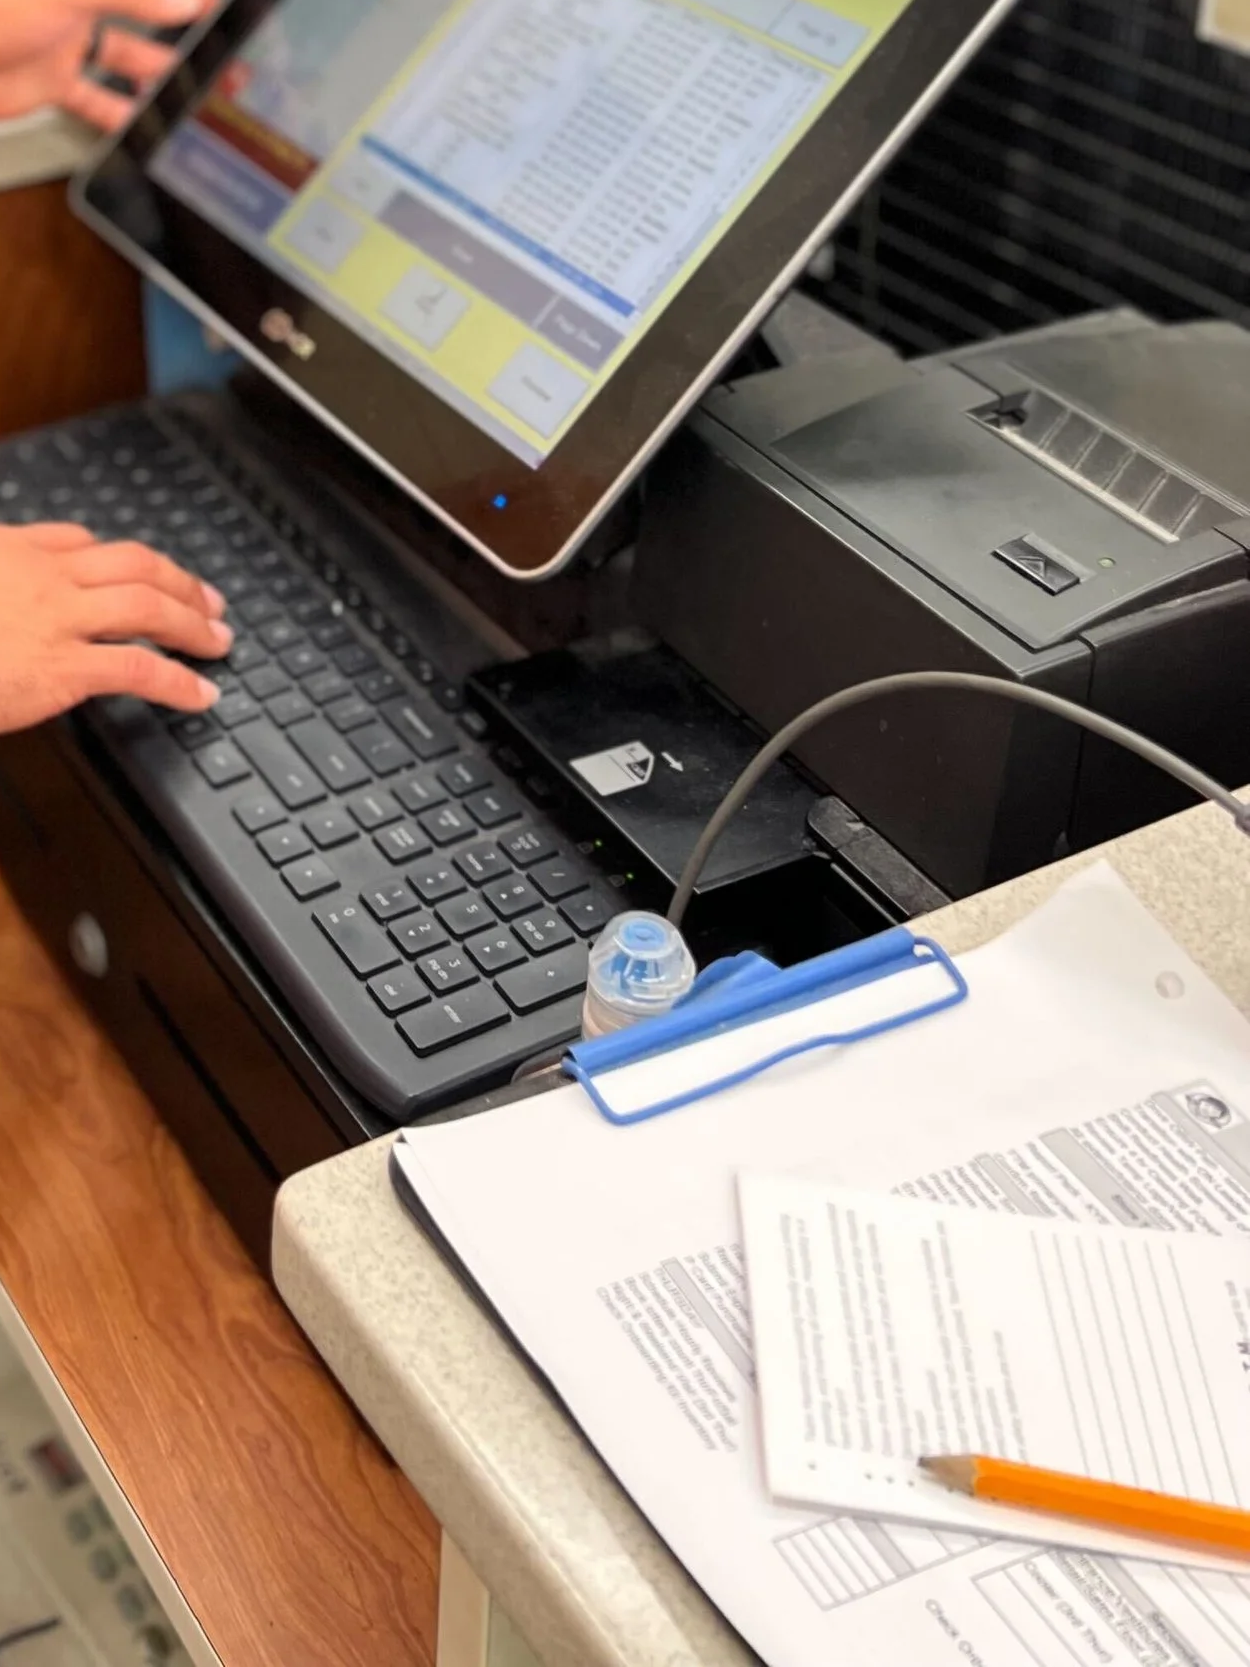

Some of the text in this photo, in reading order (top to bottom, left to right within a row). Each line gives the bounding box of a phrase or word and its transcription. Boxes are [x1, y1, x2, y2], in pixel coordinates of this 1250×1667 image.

[484, 852, 496, 860] 7
[465, 853, 483, 871] home
[512, 886, 525, 894] 8
[466, 904, 479, 914] 5
[418, 923, 431, 933] 2
[545, 919, 556, 928] 9
[496, 940, 507, 949] 6
[448, 958, 461, 968] 3
